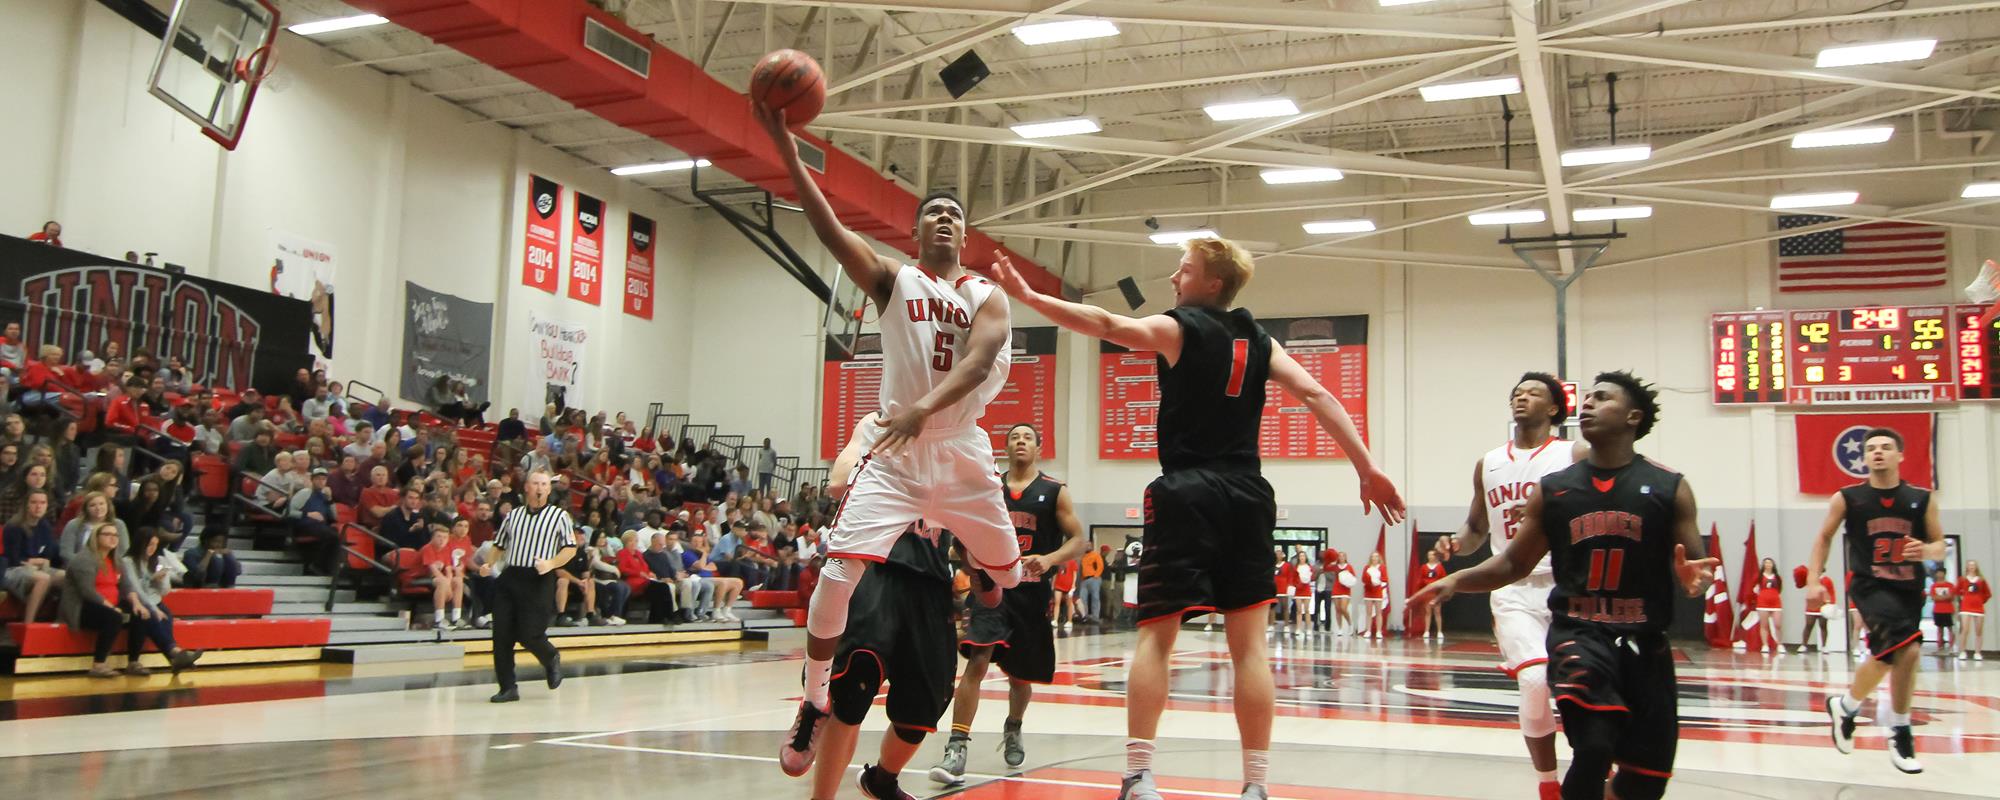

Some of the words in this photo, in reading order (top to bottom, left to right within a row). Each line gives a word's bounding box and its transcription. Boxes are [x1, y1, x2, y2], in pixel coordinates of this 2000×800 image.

[527, 245, 554, 270] 2014
[573, 260, 597, 283] 2014
[906, 298, 972, 329] UNIO
[1852, 308, 1900, 330] 2:49
[1966, 315, 1981, 329] 5
[21, 265, 260, 394] UNION
[1800, 322, 1830, 343] 42
[1913, 318, 1945, 341] 55
[932, 330, 955, 372] 5
[1225, 338, 1249, 397] 1
[1838, 365, 1852, 381] 3
[1890, 364, 1906, 380] 4
[1922, 362, 1940, 380] 5
[1487, 481, 1537, 508] UNIO
[1569, 510, 1643, 545] RHODES
[1586, 548, 1625, 591] 11
[1567, 596, 1648, 624] COLLEGE
